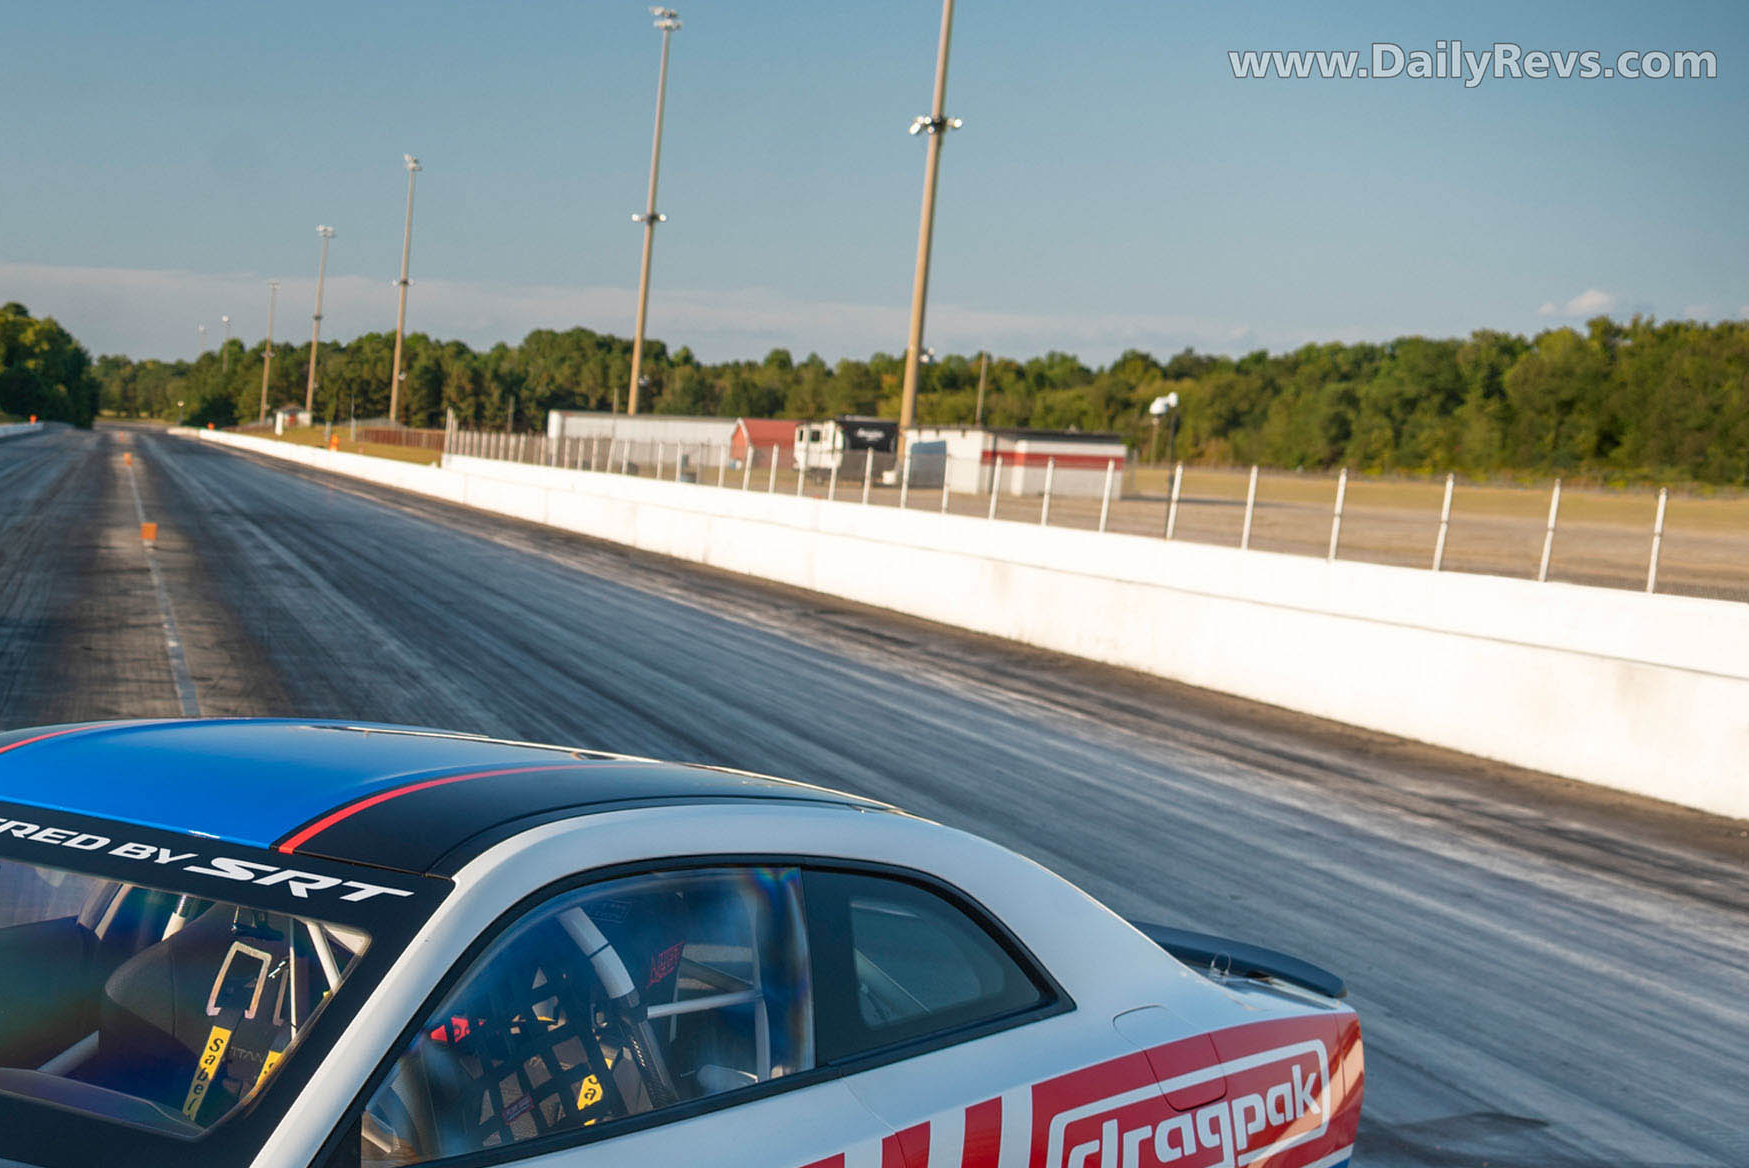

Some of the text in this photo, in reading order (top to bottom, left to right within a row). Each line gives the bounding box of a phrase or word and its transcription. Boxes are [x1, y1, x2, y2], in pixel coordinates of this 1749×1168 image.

[108, 843, 198, 865] BY
[183, 856, 415, 902] SRT
[185, 1038, 225, 1119] Sabel
